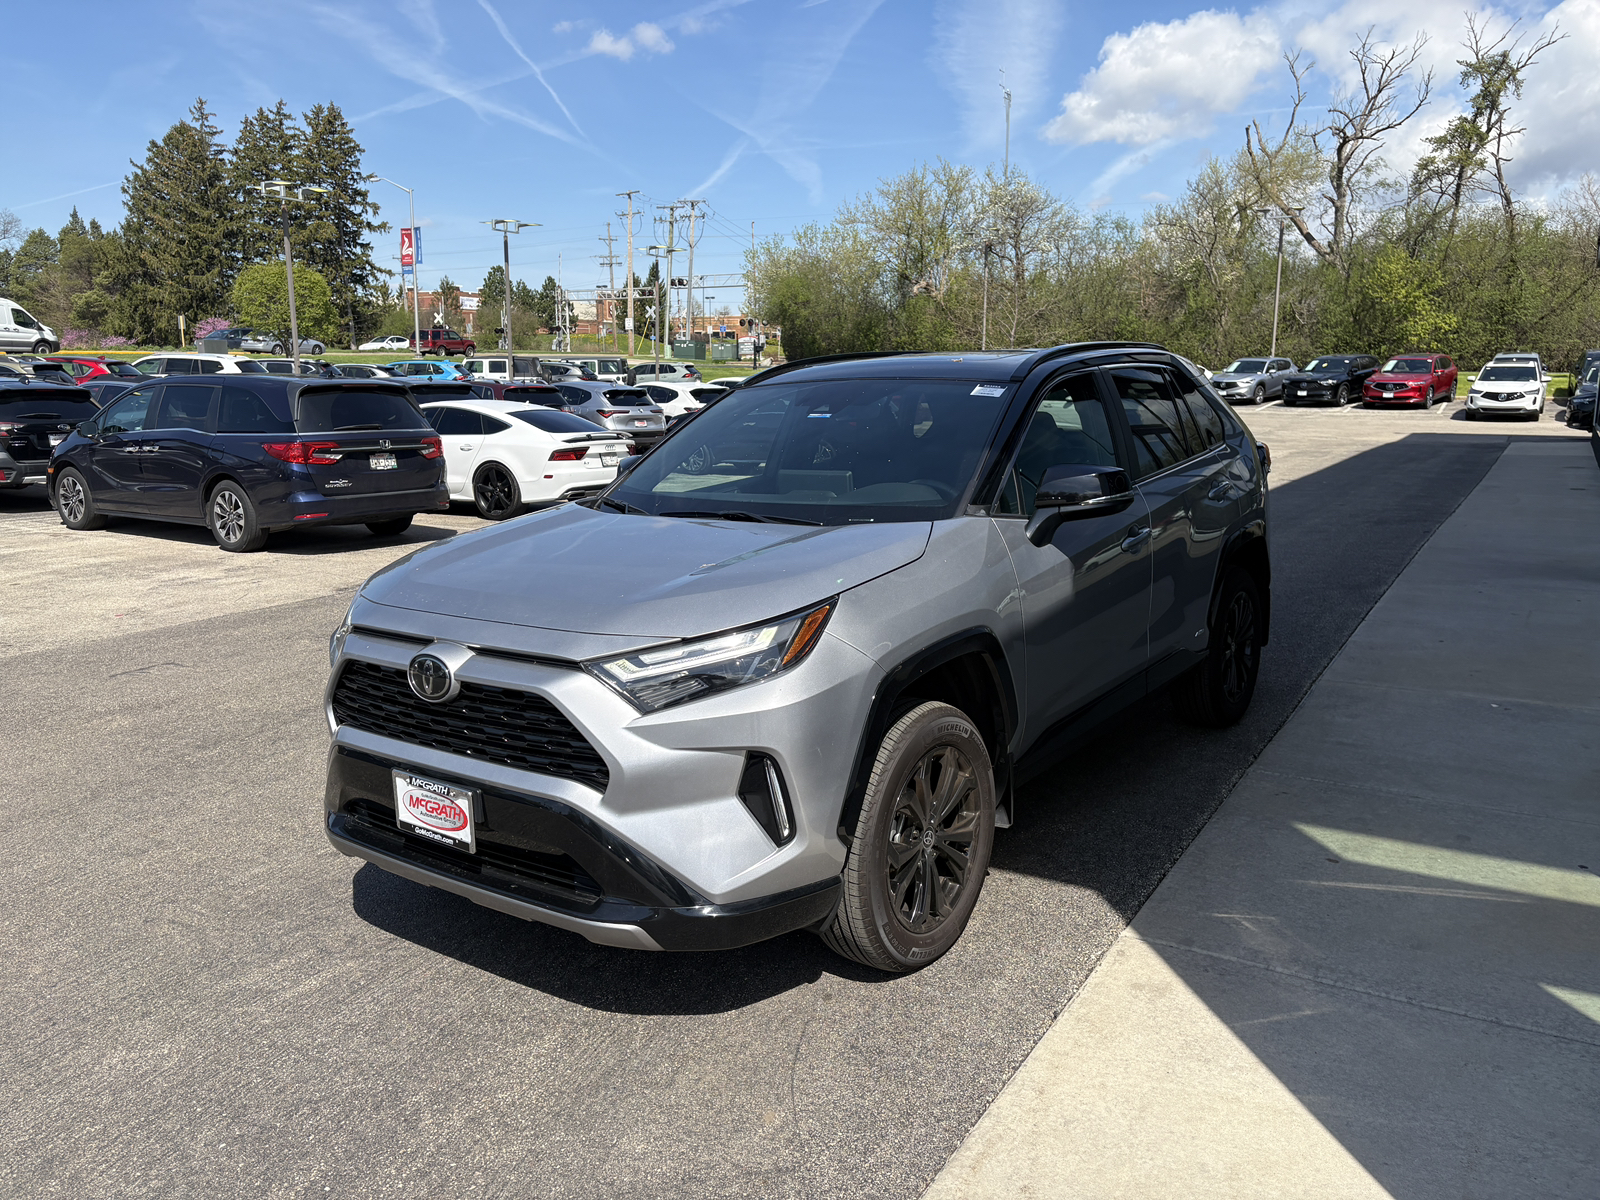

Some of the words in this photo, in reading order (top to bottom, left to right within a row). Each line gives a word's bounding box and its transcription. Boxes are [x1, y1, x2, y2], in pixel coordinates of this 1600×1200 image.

[937, 723, 970, 735] MICHELIN
[409, 795, 461, 822] McGRATH
[420, 811, 443, 821] Automotive
[443, 817, 457, 826] Group
[414, 826, 454, 845] GoMcGrath.com
